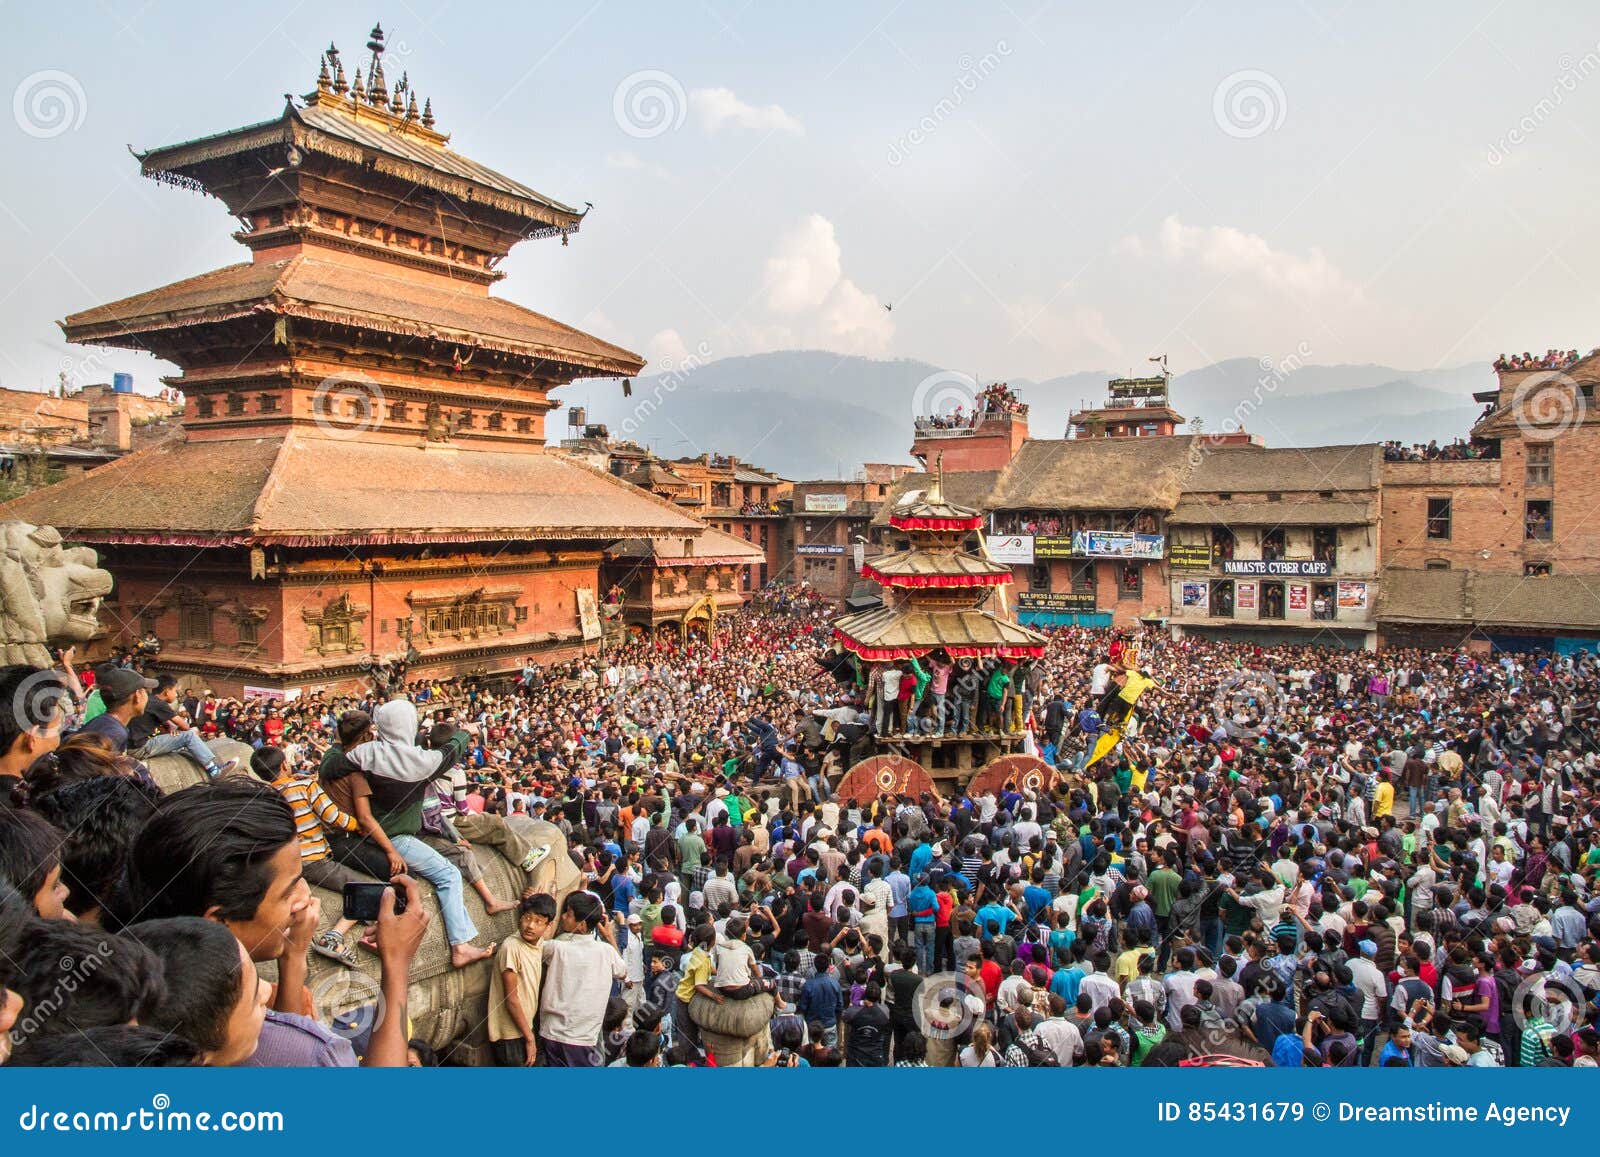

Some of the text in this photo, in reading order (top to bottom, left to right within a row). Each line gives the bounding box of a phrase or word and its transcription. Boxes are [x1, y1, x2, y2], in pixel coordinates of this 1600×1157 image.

[1225, 562, 1327, 574] NAMASTE CYBER CAFE
